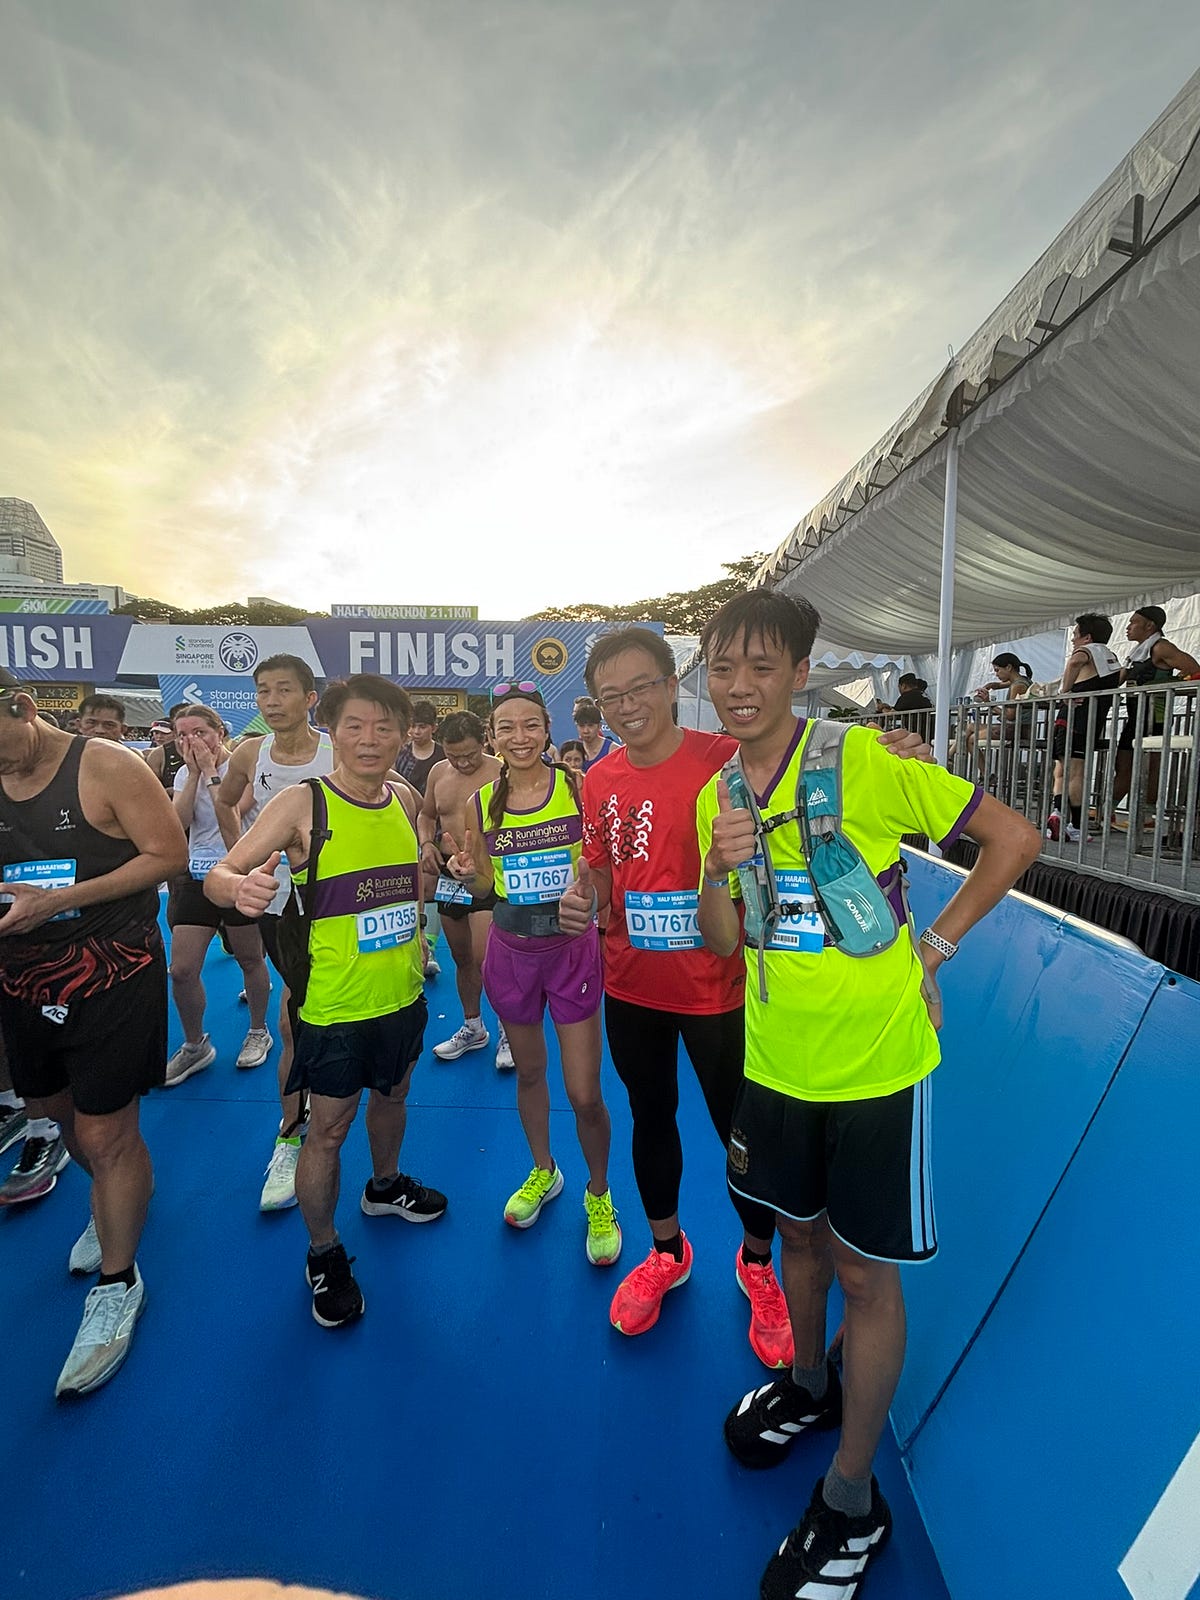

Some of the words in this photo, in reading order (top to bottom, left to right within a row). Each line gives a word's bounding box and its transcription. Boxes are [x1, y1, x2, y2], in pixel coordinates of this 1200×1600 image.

[23, 600, 48, 612] 5KM
[337, 606, 364, 617] HALF
[367, 606, 426, 618] MARATHON
[430, 607, 471, 618] 21.1KM
[349, 631, 514, 677] FINISH
[37, 700, 73, 708] SEIKO
[210, 699, 258, 710] chartere
[515, 824, 568, 840] Runninghour
[537, 836, 558, 845] OTHERS
[509, 868, 570, 890] D17667
[364, 907, 416, 935] D17355
